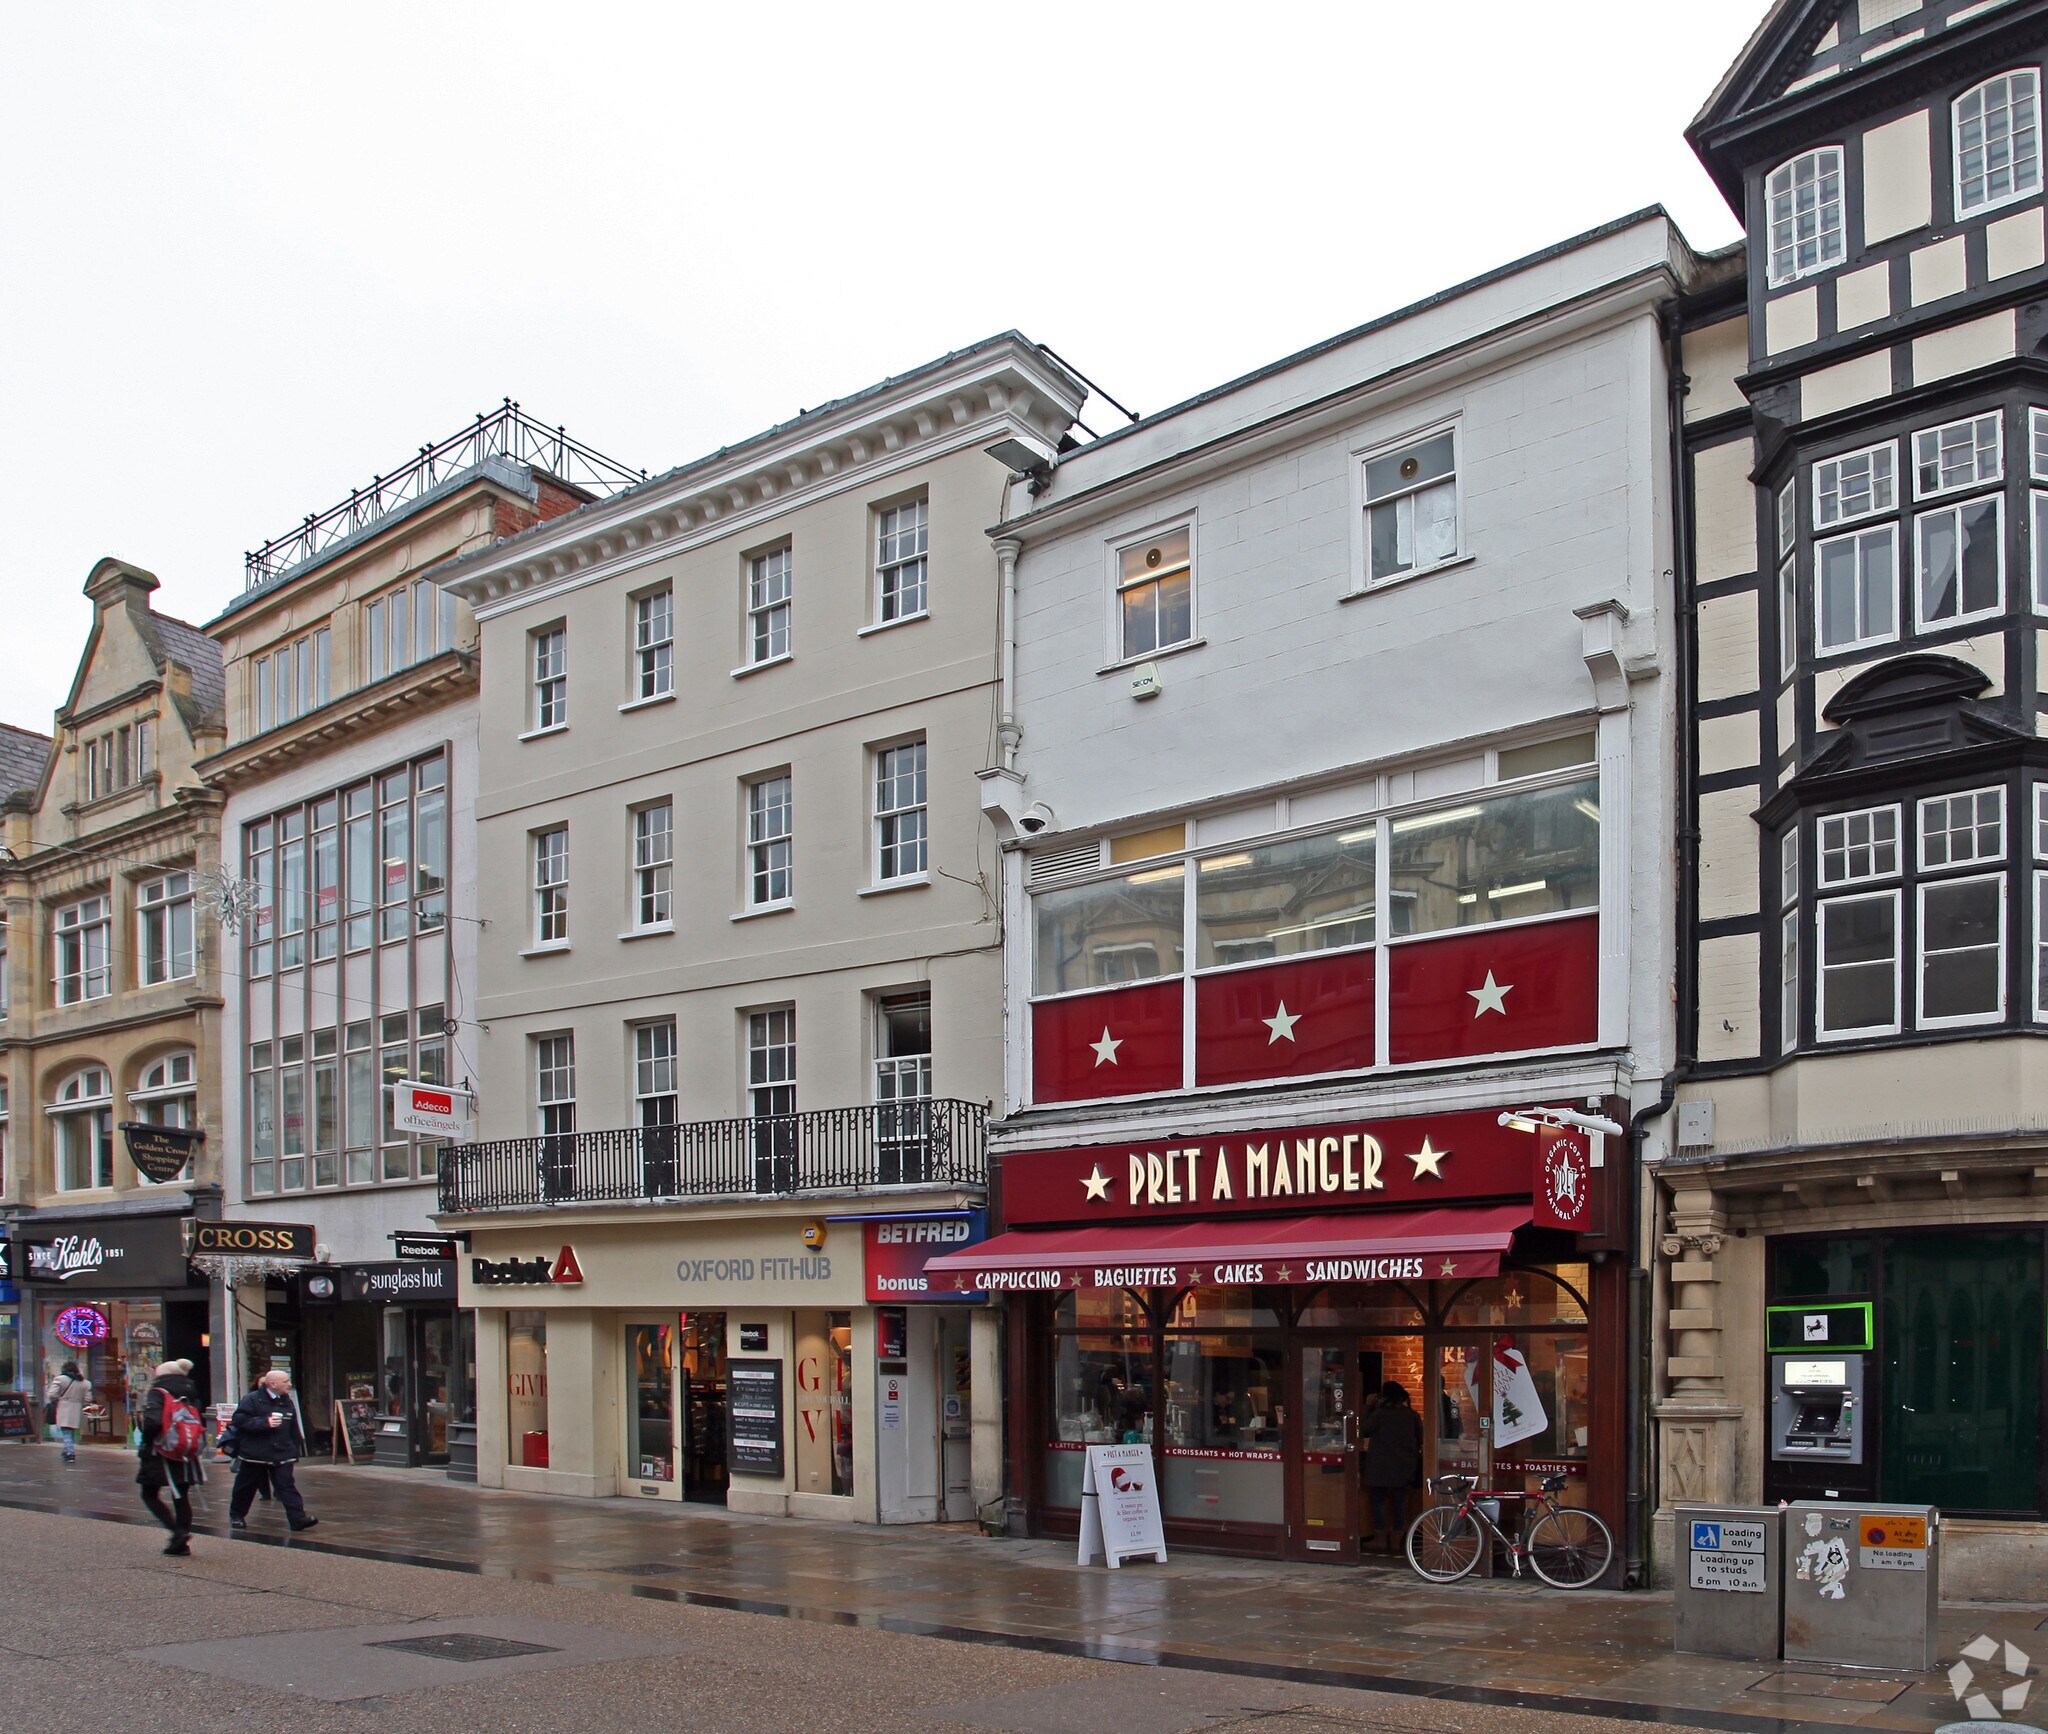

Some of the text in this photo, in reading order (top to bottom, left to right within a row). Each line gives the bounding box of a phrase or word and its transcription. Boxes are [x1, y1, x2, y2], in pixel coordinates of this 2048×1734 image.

[415, 1100, 450, 1112] Adecco
[152, 1134, 170, 1144] The
[134, 1142, 188, 1155] Golden Cross
[142, 1153, 179, 1165] Shopping
[1545, 1139, 1586, 1178] ORGANIC COFFEE
[147, 1163, 175, 1173] Centre
[1129, 1133, 1384, 1205] PRET A MANGER
[1546, 1188, 1585, 1220] NATURAL FOOD
[877, 1221, 970, 1244] BETFRED
[200, 1228, 294, 1250] CROSS
[28, 1235, 124, 1271] SINCE Kiehl's 1851
[401, 1244, 440, 1256] Reebok
[472, 1256, 553, 1285] Reebok
[677, 1256, 831, 1282] OXFORD FITHUB
[974, 1257, 1424, 1290] CAPPUCCINO BAGUETTES CAKES SANDWICHES
[371, 1267, 443, 1294] sunglass hut
[877, 1274, 928, 1291] bonus
[1054, 1442, 1075, 1450] LATTE
[1172, 1448, 1219, 1457] CROISSANTS
[1246, 1452, 1273, 1460] WRAPS
[1524, 1463, 1568, 1473] TOASTIES
[1723, 1528, 1762, 1539] Loading
[1731, 1539, 1752, 1548] only
[1700, 1555, 1738, 1566] Loading
[1885, 1551, 1912, 1559] loading
